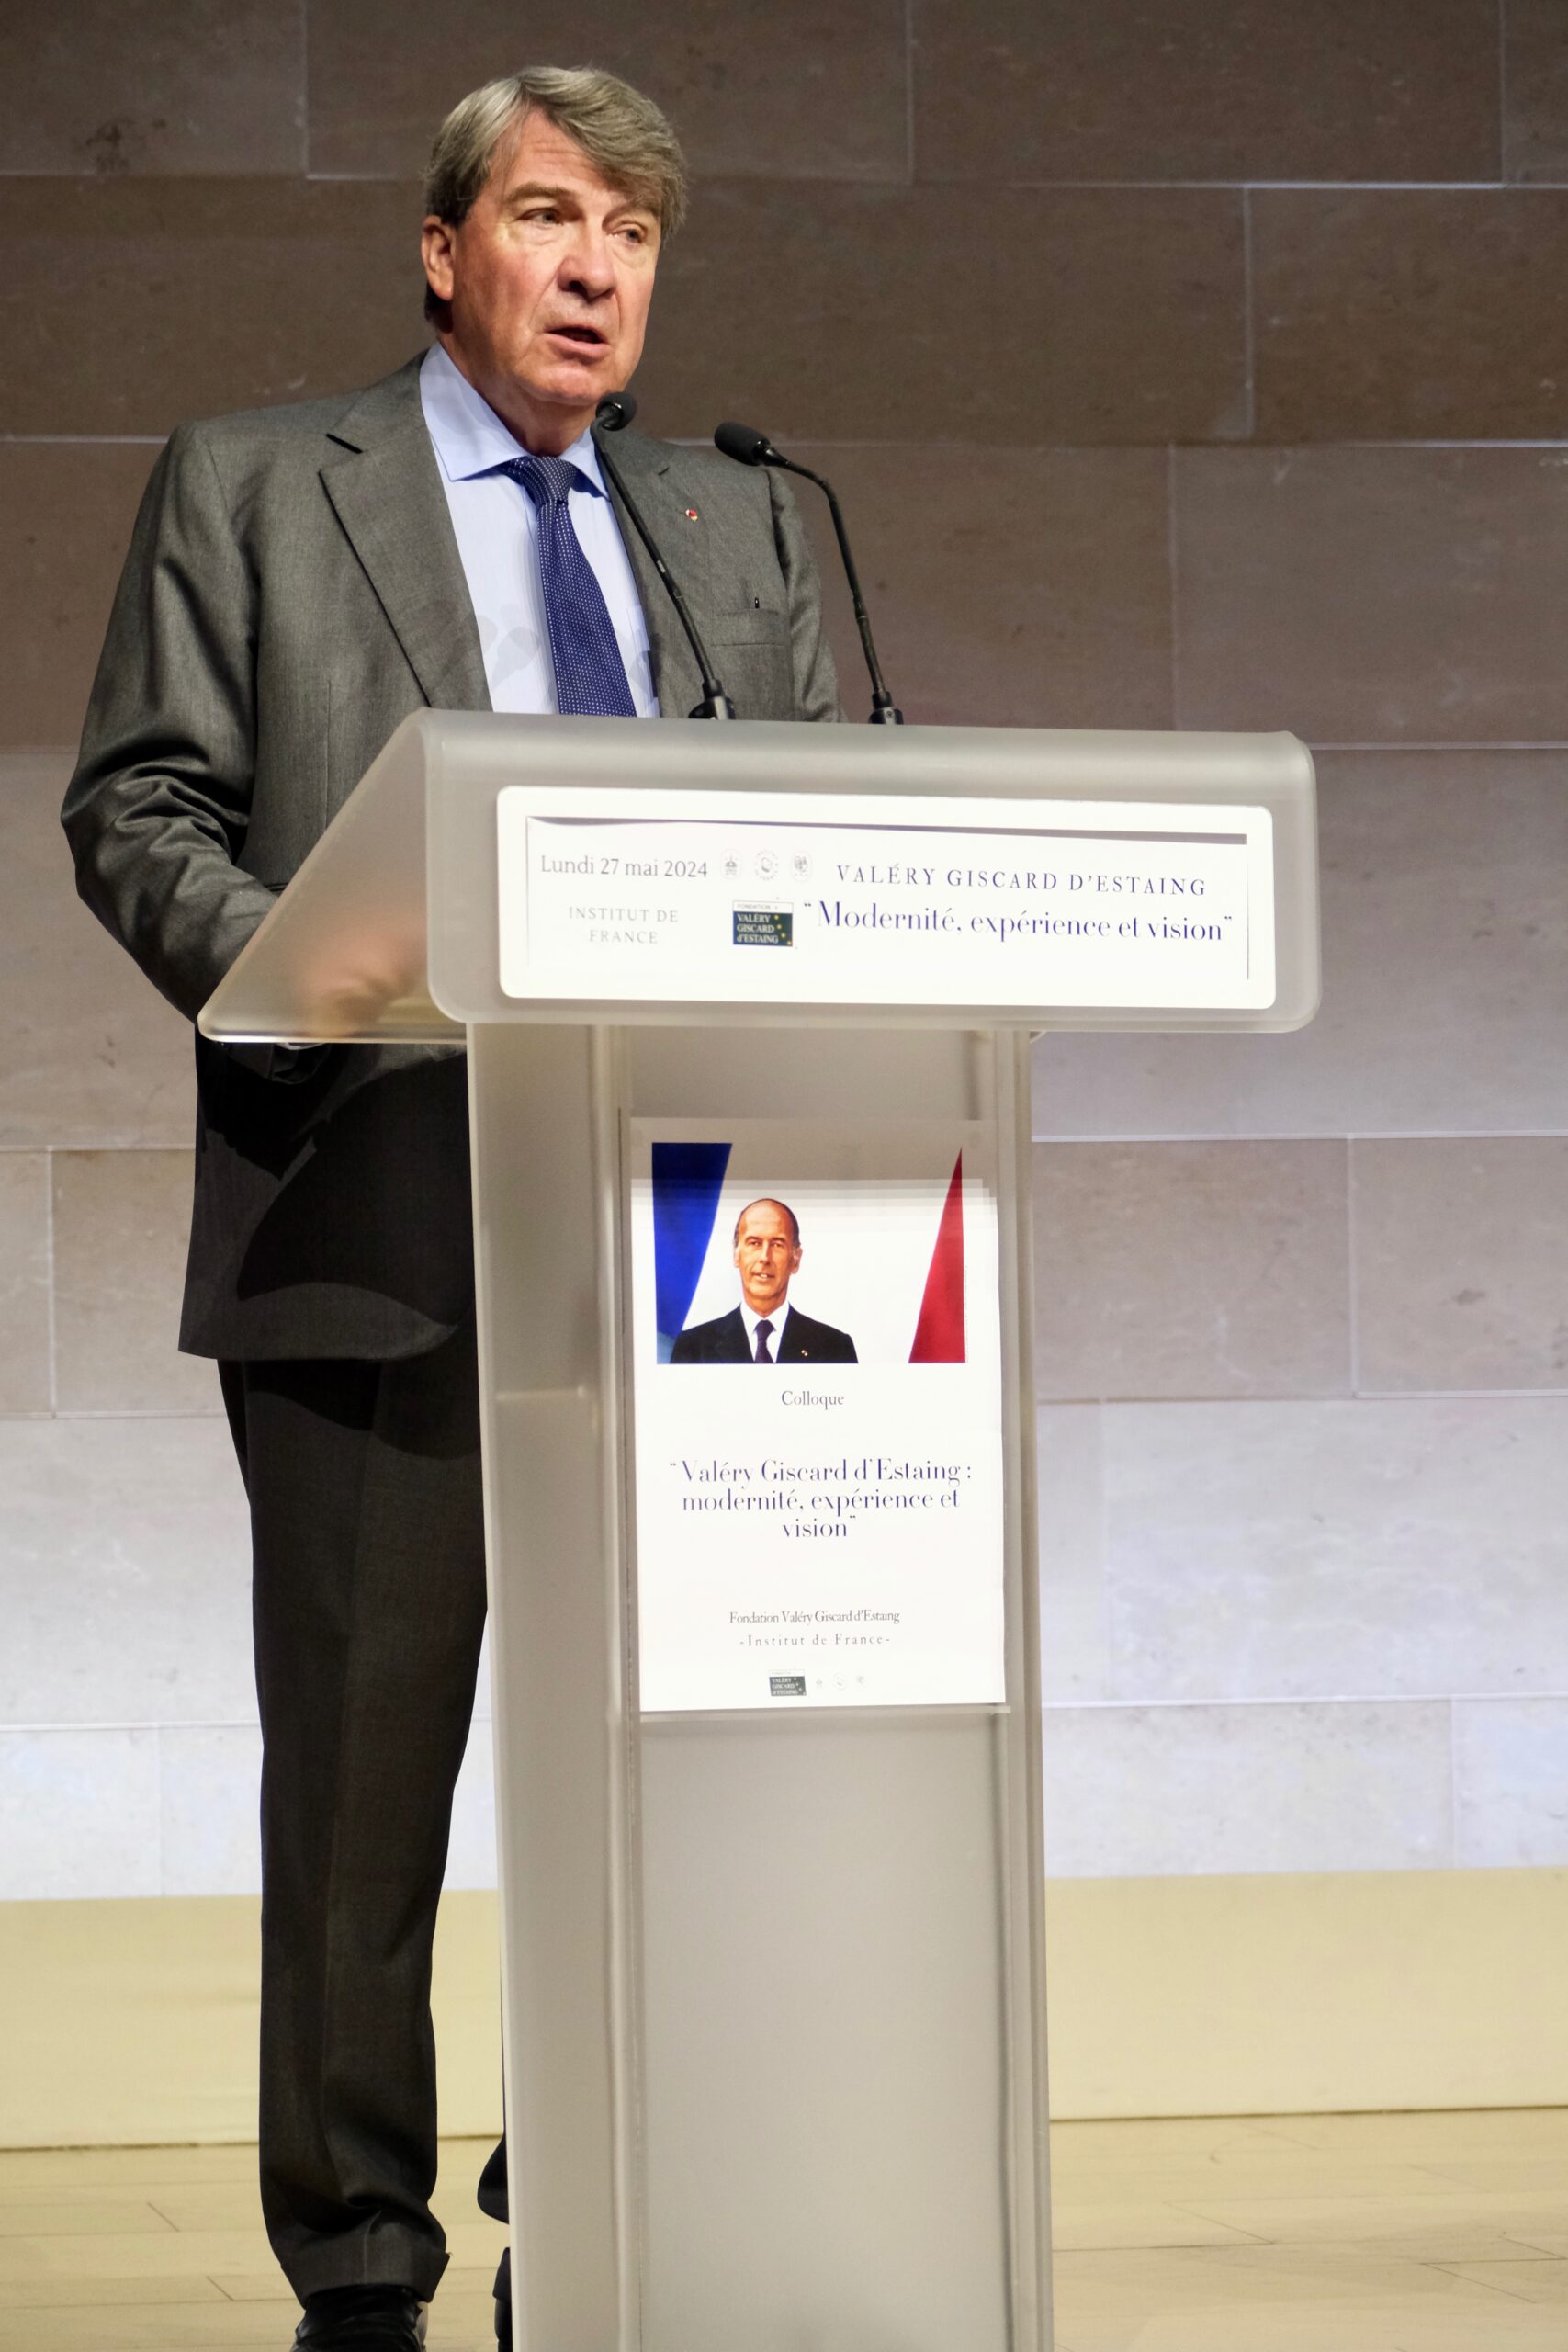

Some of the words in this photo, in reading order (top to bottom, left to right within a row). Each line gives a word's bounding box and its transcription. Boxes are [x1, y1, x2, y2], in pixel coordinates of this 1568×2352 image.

[540, 855, 594, 874] Lundi
[600, 858, 619, 876] 27
[625, 859, 659, 876] mai
[664, 860, 707, 878] 2024
[837, 864, 936, 885] VALÉRY
[947, 868, 1057, 890] GISCARD
[569, 906, 649, 922] INSTITUT
[657, 909, 679, 923] DE
[737, 922, 774, 934] GISCARD
[970, 910, 1111, 943] expérience
[1118, 917, 1141, 938] et
[590, 930, 659, 944] FRANCE
[781, 1390, 844, 1410] Colloque
[761, 1458, 847, 1482] Giscard
[682, 1488, 804, 1511] modernité,
[811, 1488, 933, 1517] expérience
[940, 1488, 960, 1508] et
[729, 1611, 779, 1623] Fondation
[782, 1611, 813, 1626] Valéry
[815, 1610, 852, 1623] Giscard
[812, 1634, 827, 1645] de
